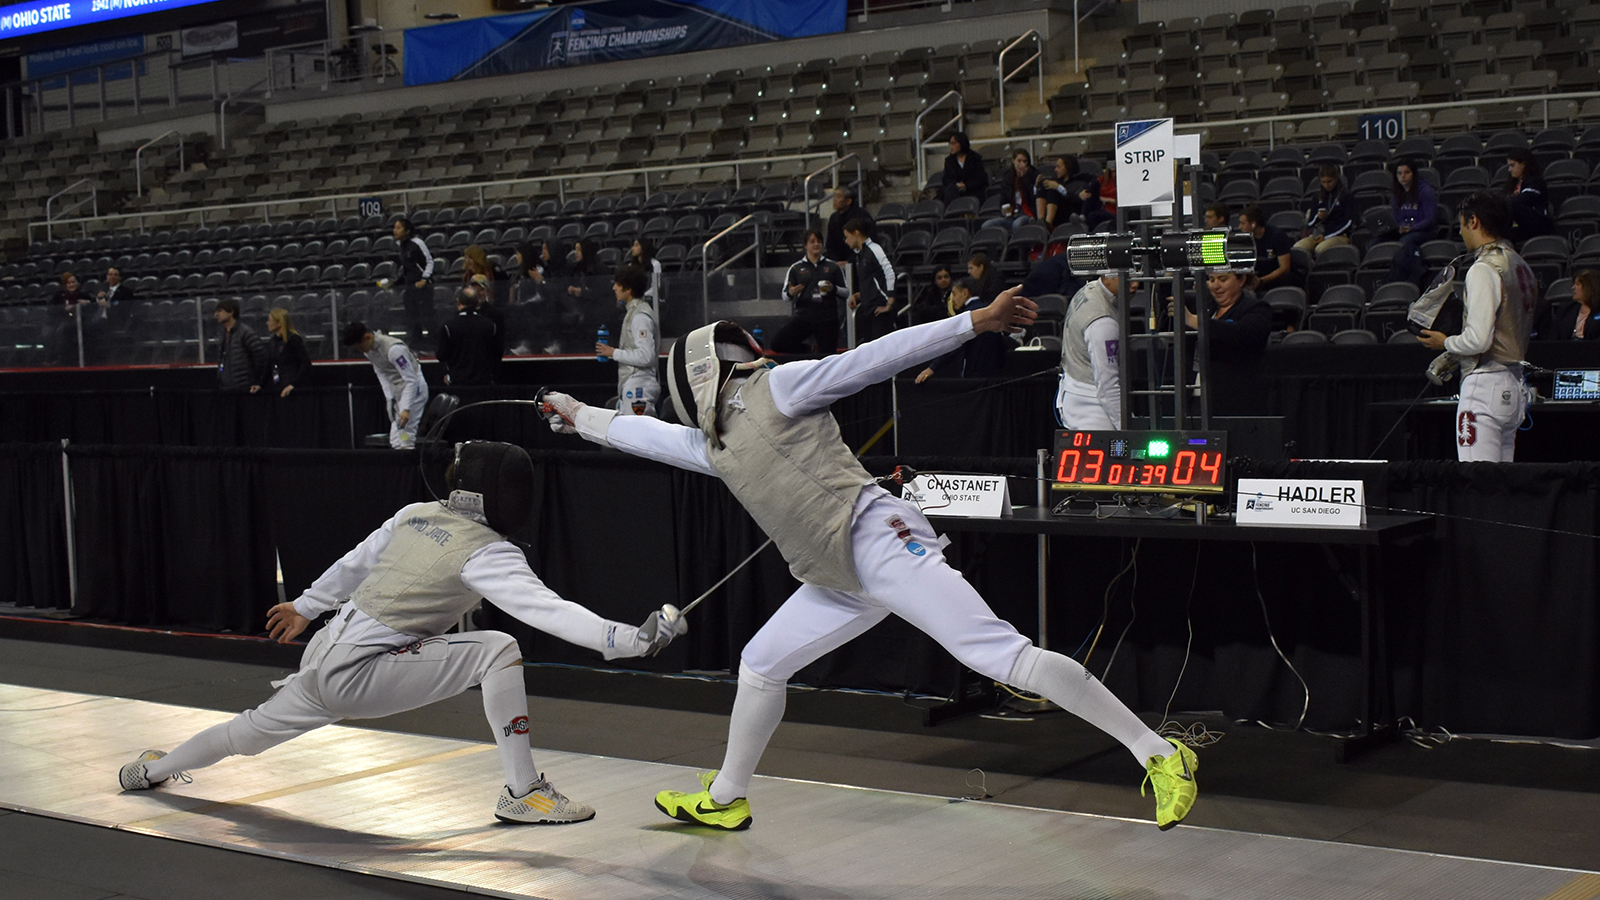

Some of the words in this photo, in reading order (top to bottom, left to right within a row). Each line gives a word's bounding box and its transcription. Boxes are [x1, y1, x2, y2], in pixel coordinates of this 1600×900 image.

[13, 9, 39, 28] OHIO
[40, 3, 71, 24] STATE
[567, 35, 606, 51] FENCING
[608, 25, 688, 47] CHAMPIONSHIPS
[1361, 118, 1399, 140] 110
[1124, 149, 1165, 165] STRIP
[1142, 169, 1150, 182] 2
[360, 201, 381, 217] 109
[1073, 432, 1092, 447] 01
[1056, 450, 1105, 483] 03
[1108, 464, 1167, 485] 01:39
[1171, 450, 1222, 485] 04
[927, 479, 999, 492] CHASTANET
[960, 494, 980, 502] STATE
[1278, 486, 1356, 503] HADLER
[426, 527, 453, 547] STATE
